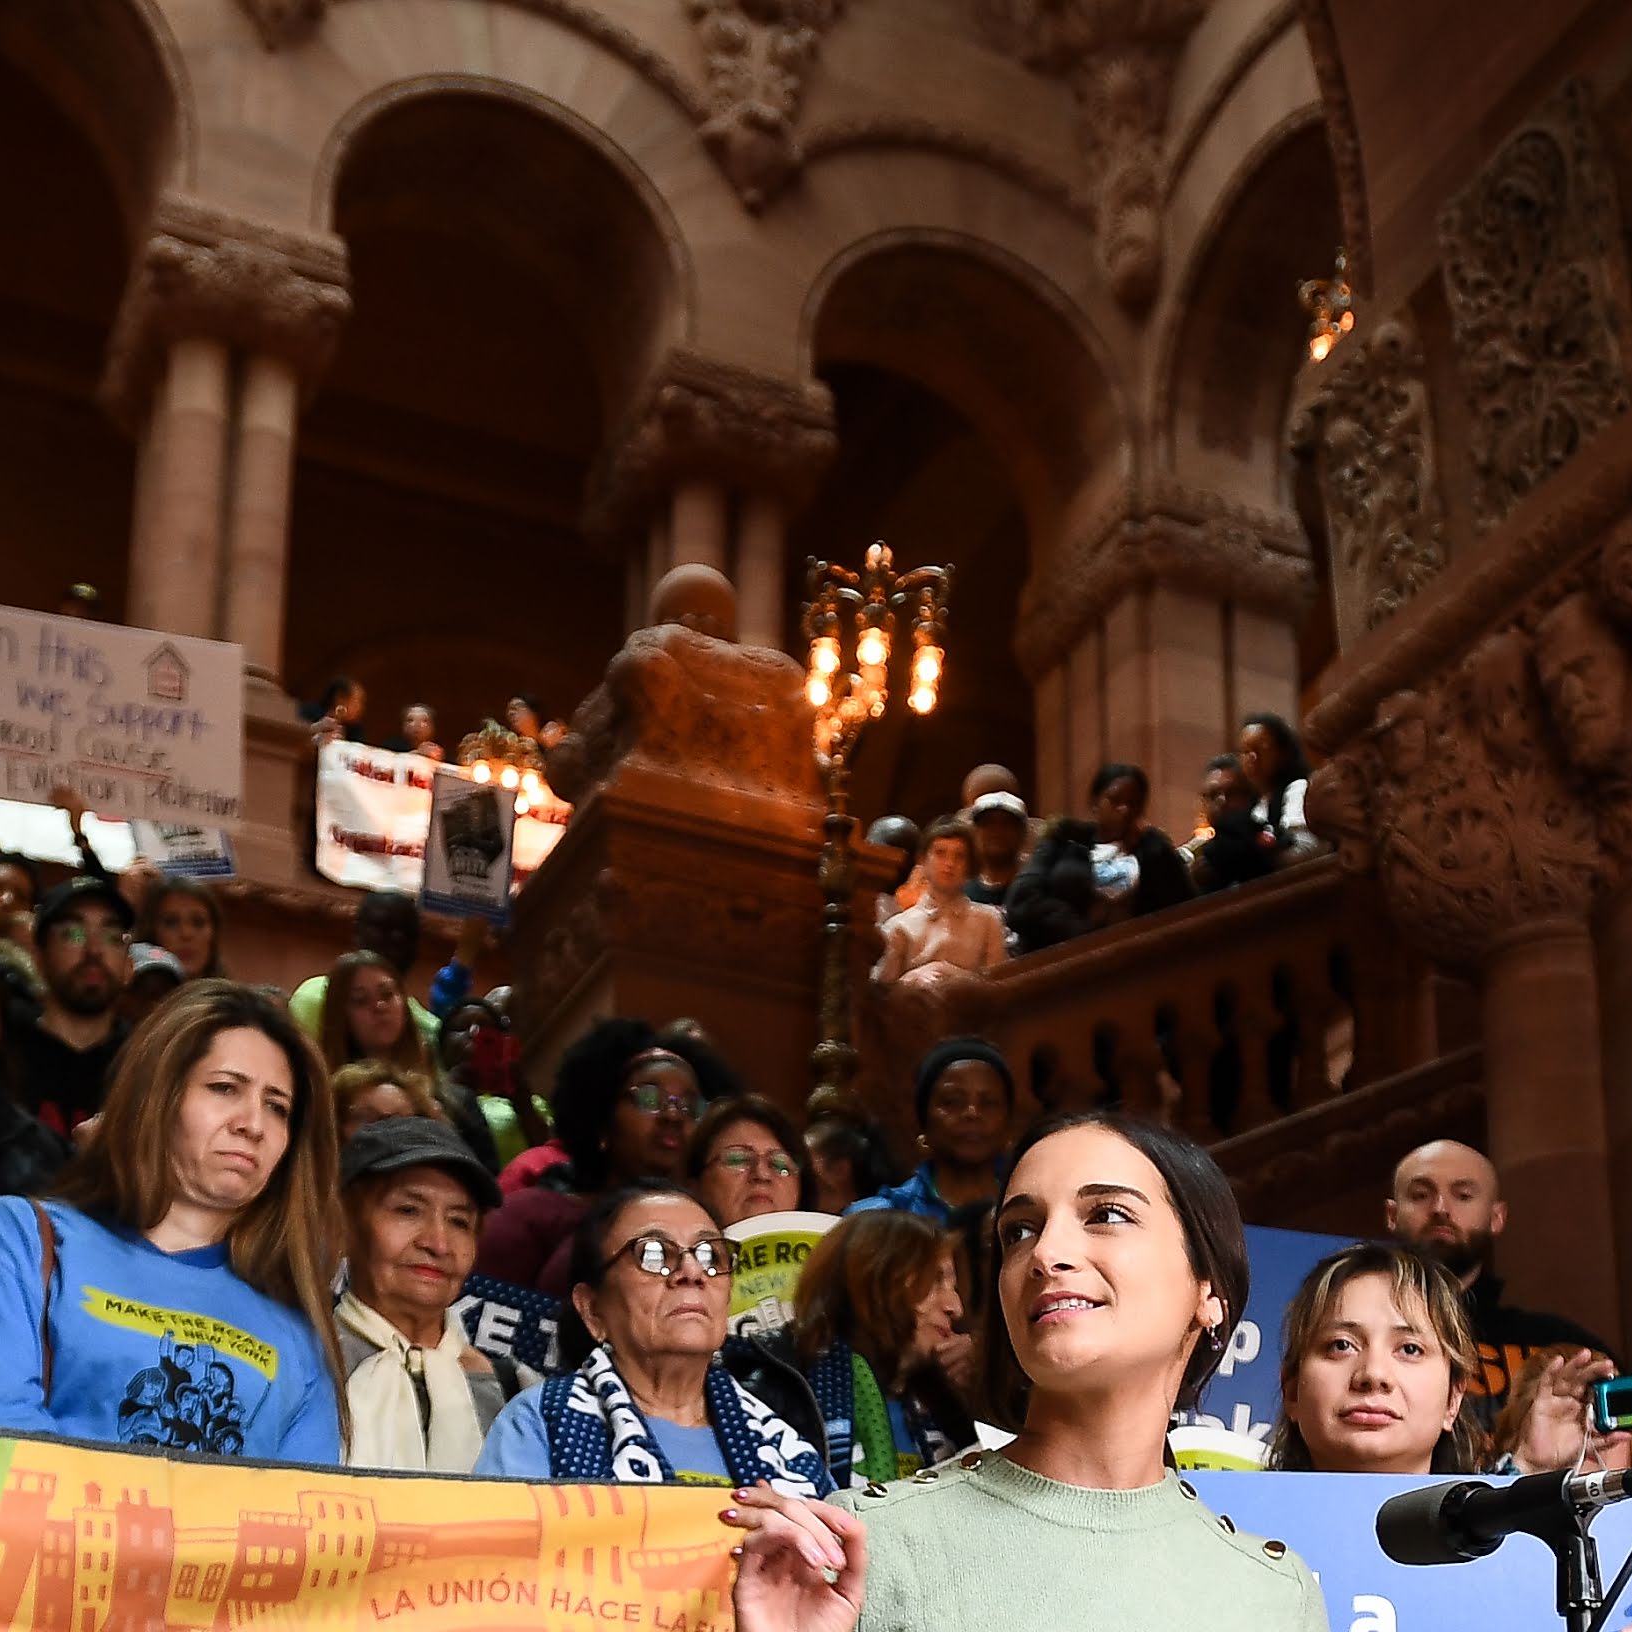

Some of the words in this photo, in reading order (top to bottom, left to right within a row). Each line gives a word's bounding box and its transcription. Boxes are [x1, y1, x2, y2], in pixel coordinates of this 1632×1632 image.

[104, 1298, 165, 1324] MAKE
[170, 1313, 206, 1330] THE
[182, 1328, 223, 1345] NEW
[370, 1588, 417, 1622] LA
[426, 1571, 538, 1607] UNIÓN
[550, 1588, 642, 1623] HACE
